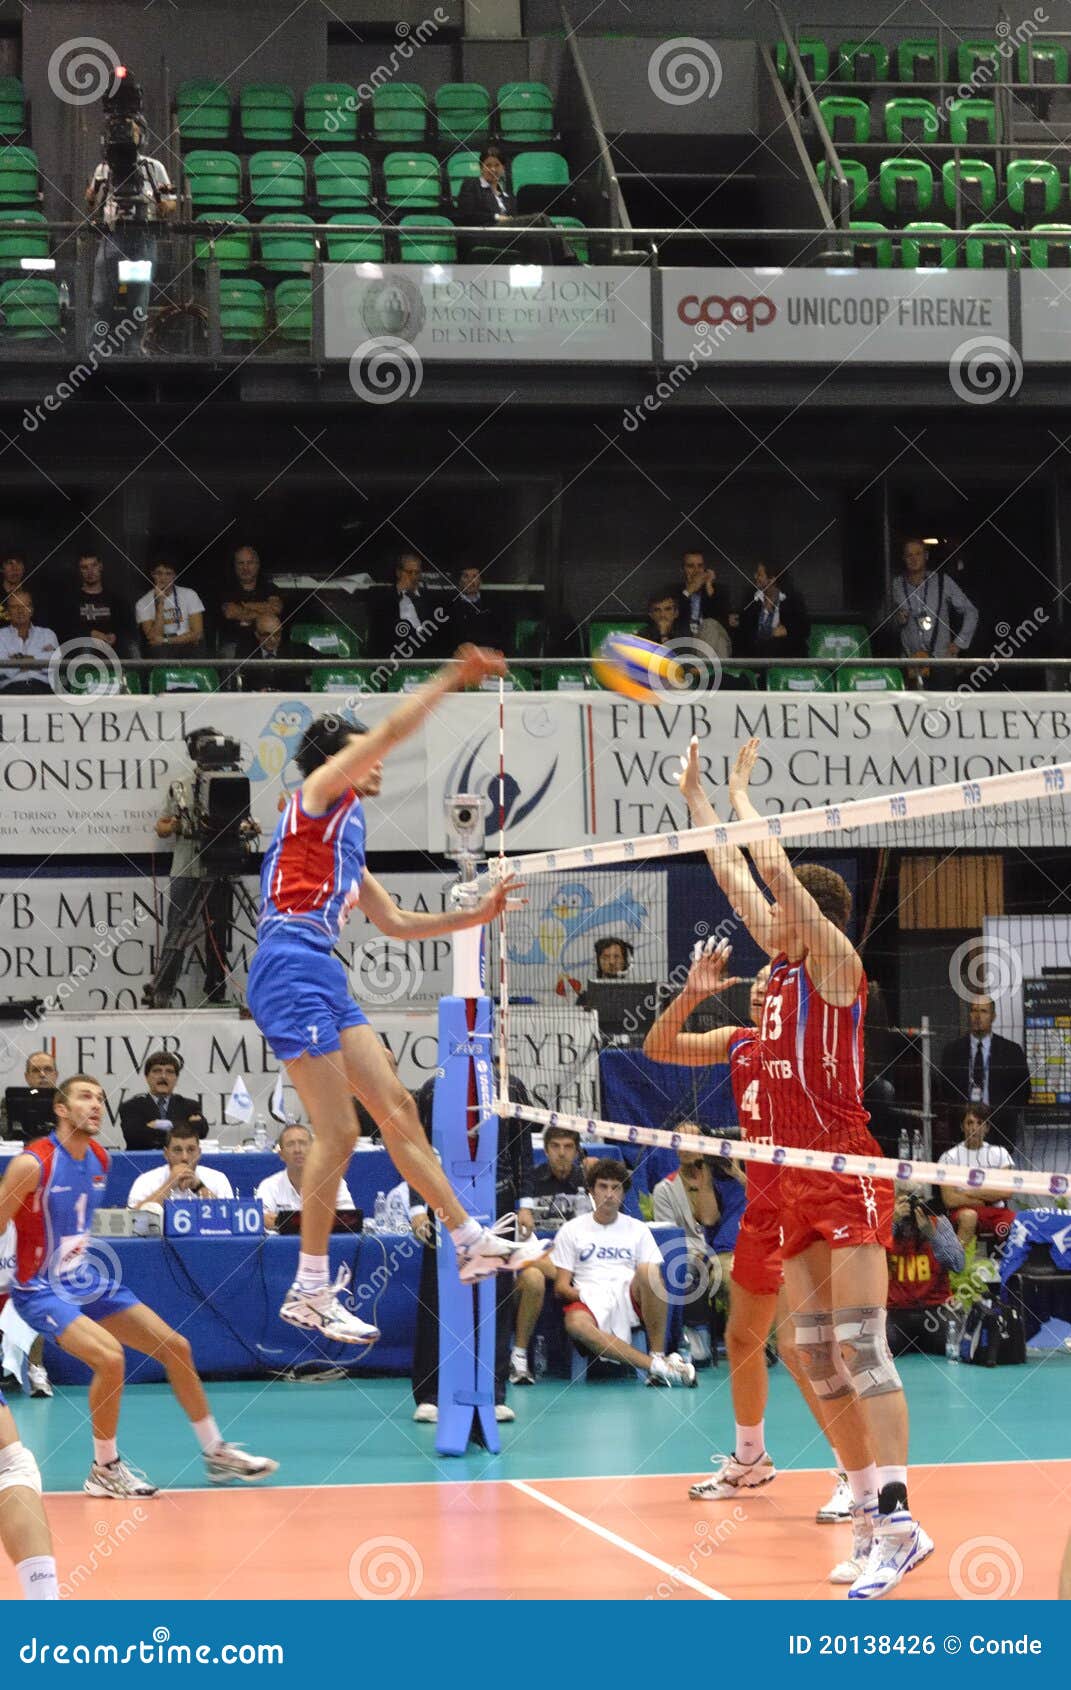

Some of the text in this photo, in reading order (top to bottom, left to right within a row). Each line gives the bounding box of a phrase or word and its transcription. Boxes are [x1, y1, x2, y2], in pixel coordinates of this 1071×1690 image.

[432, 279, 616, 301] FONDAZIONE
[432, 306, 507, 323] MONTE
[549, 305, 616, 324] PASCHI
[677, 295, 992, 333] coop UNICOOP FIRENZE
[432, 326, 516, 344] DI SIENA
[610, 703, 712, 739] FIVB
[734, 702, 872, 740] MEN'S
[761, 994, 783, 1041] 13
[766, 1059, 793, 1079] VTB
[740, 1080, 762, 1121] 4
[173, 1208, 192, 1234] 6
[202, 1204, 212, 1218] 2
[220, 1204, 227, 1218] 1
[234, 1207, 260, 1232] 10
[597, 1246, 632, 1260] asics
